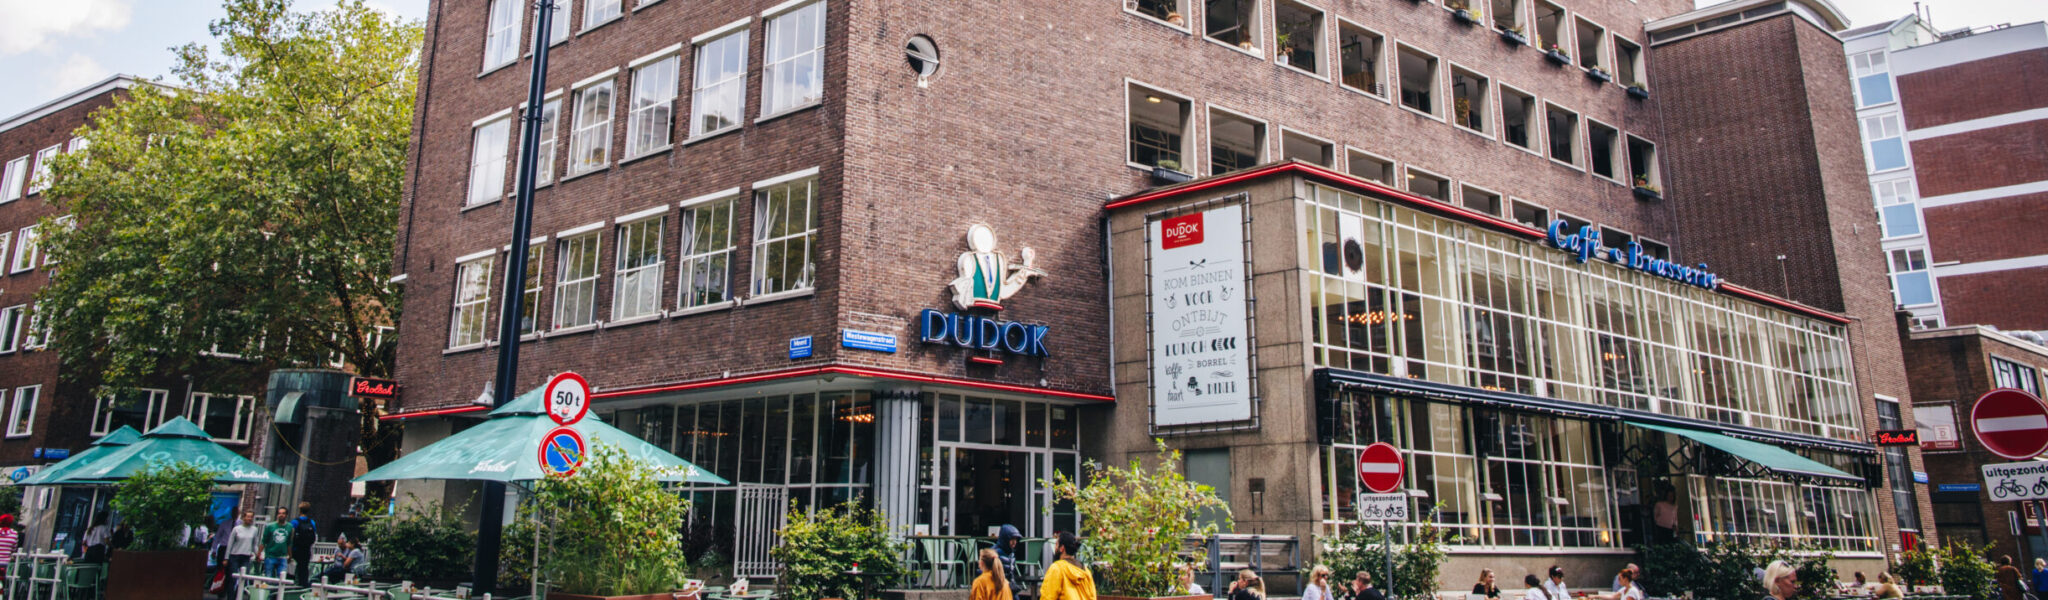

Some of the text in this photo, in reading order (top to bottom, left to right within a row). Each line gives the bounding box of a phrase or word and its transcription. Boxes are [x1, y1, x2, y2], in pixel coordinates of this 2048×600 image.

[1166, 223, 1199, 238] DUDOK
[1628, 241, 1717, 290] Brasserie
[1164, 269, 1233, 291] KOM BINNEN
[1184, 290, 1214, 306] VOOR
[1172, 309, 1228, 332] ONTBIJT
[921, 308, 1049, 357] DUDOK
[1165, 340, 1208, 357] LUNCH
[1196, 358, 1227, 368] BORREL
[356, 380, 394, 395] Grolsch
[556, 391, 580, 407] 50 t
[1879, 432, 1915, 444] Grolsch
